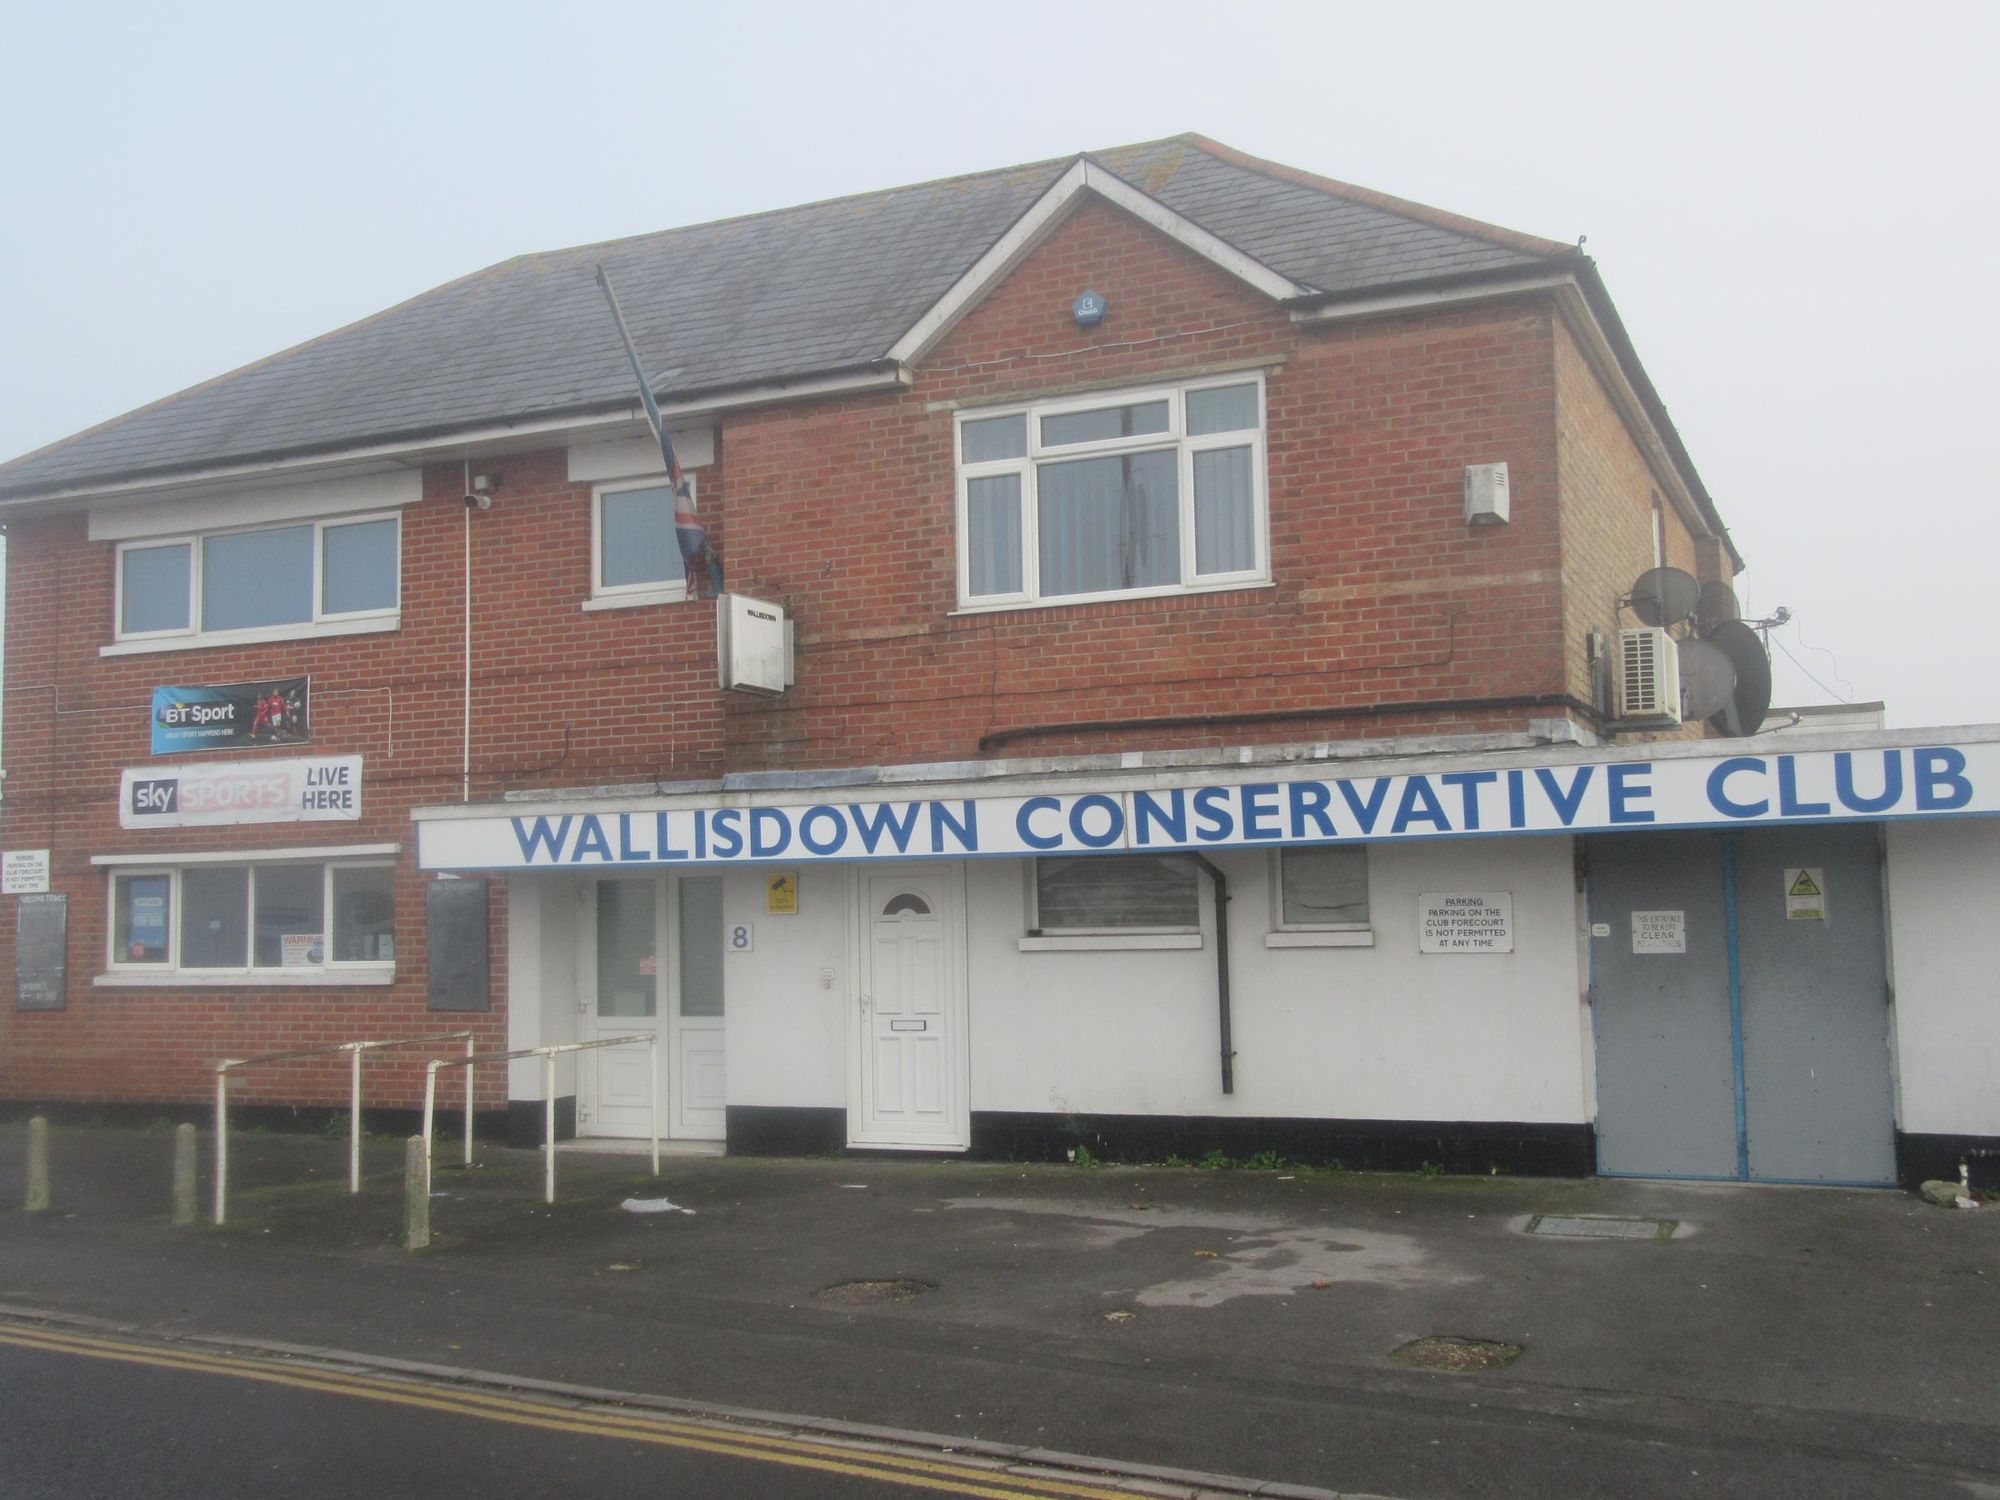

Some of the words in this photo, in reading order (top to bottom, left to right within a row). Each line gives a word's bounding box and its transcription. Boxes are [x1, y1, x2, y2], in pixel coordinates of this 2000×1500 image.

[166, 707, 190, 723] BT
[192, 703, 234, 724] Sport
[307, 766, 349, 786] LIVE
[136, 782, 174, 812] sky
[180, 777, 287, 809] SPORTS
[302, 790, 353, 810] HERE
[510, 800, 977, 864] WALLISDOWN
[1015, 763, 1655, 850] CONSERVATIVE
[1705, 747, 1974, 819] CLUB
[1445, 898, 1484, 907] PARKING
[1426, 919, 1449, 927] CLUB
[1451, 919, 1505, 927] FORECOURT
[1428, 909, 1466, 917] PARKING
[1468, 909, 1482, 917] ON
[1484, 909, 1502, 917] THE
[733, 926, 748, 949] 8
[1425, 929, 1434, 937] IS
[1436, 929, 1455, 937] NOT
[1457, 929, 1506, 937] PERMITTED
[1641, 931, 1675, 940] CLEAR
